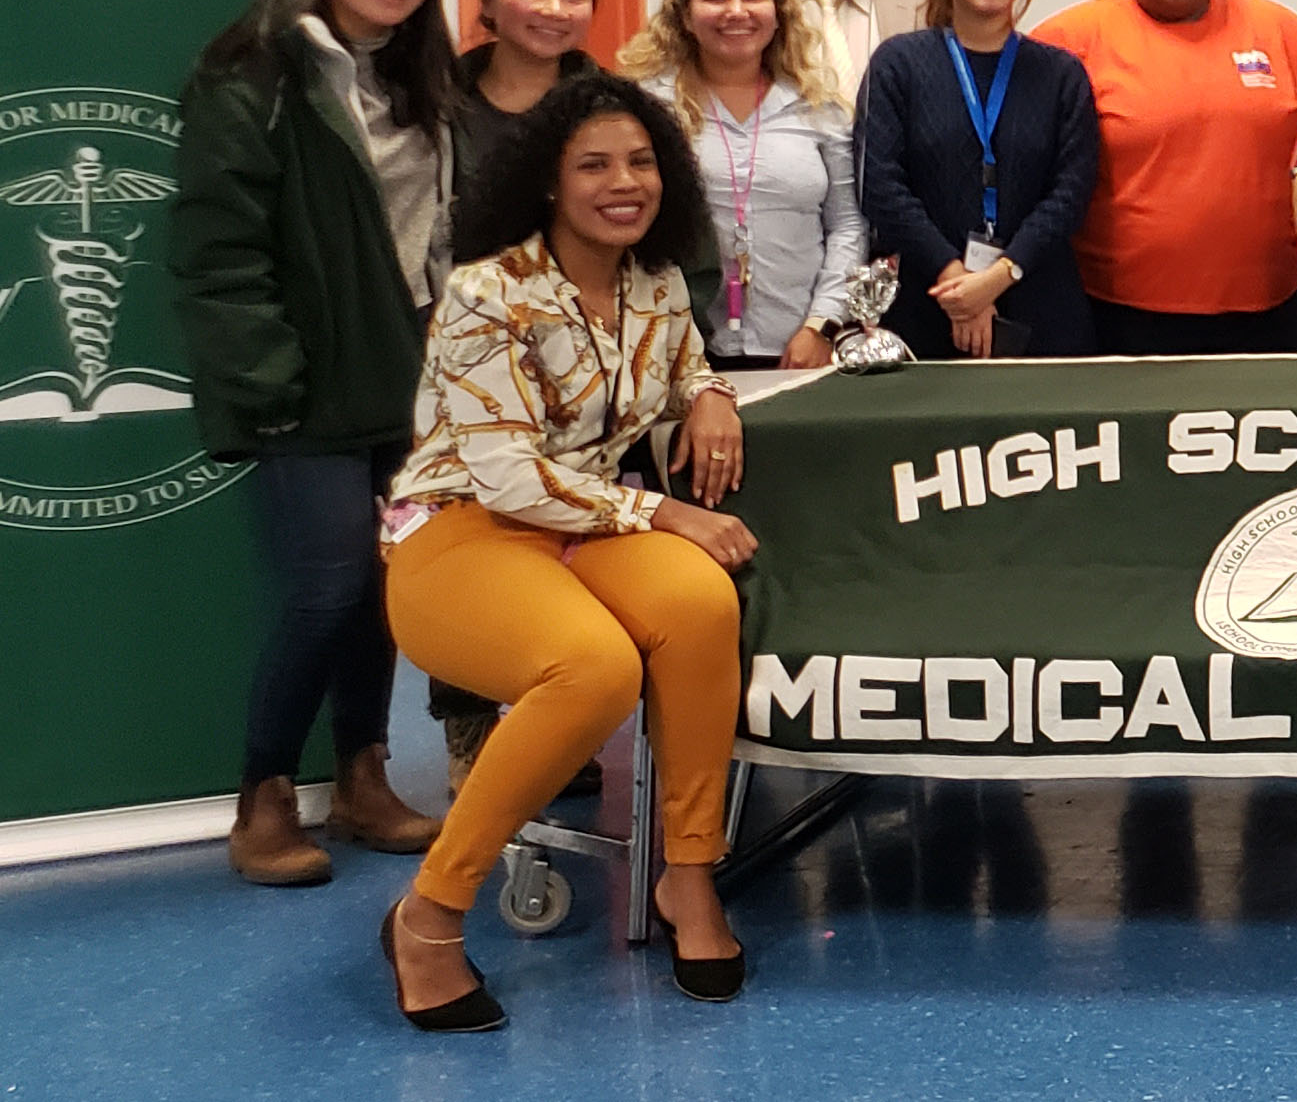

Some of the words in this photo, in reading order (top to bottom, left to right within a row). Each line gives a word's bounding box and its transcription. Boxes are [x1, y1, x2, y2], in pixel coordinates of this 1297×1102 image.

[139, 478, 184, 507] TO
[893, 420, 1121, 524] HIGH
[1221, 538, 1250, 576] HIGH
[746, 653, 1292, 744] MEDICAL
